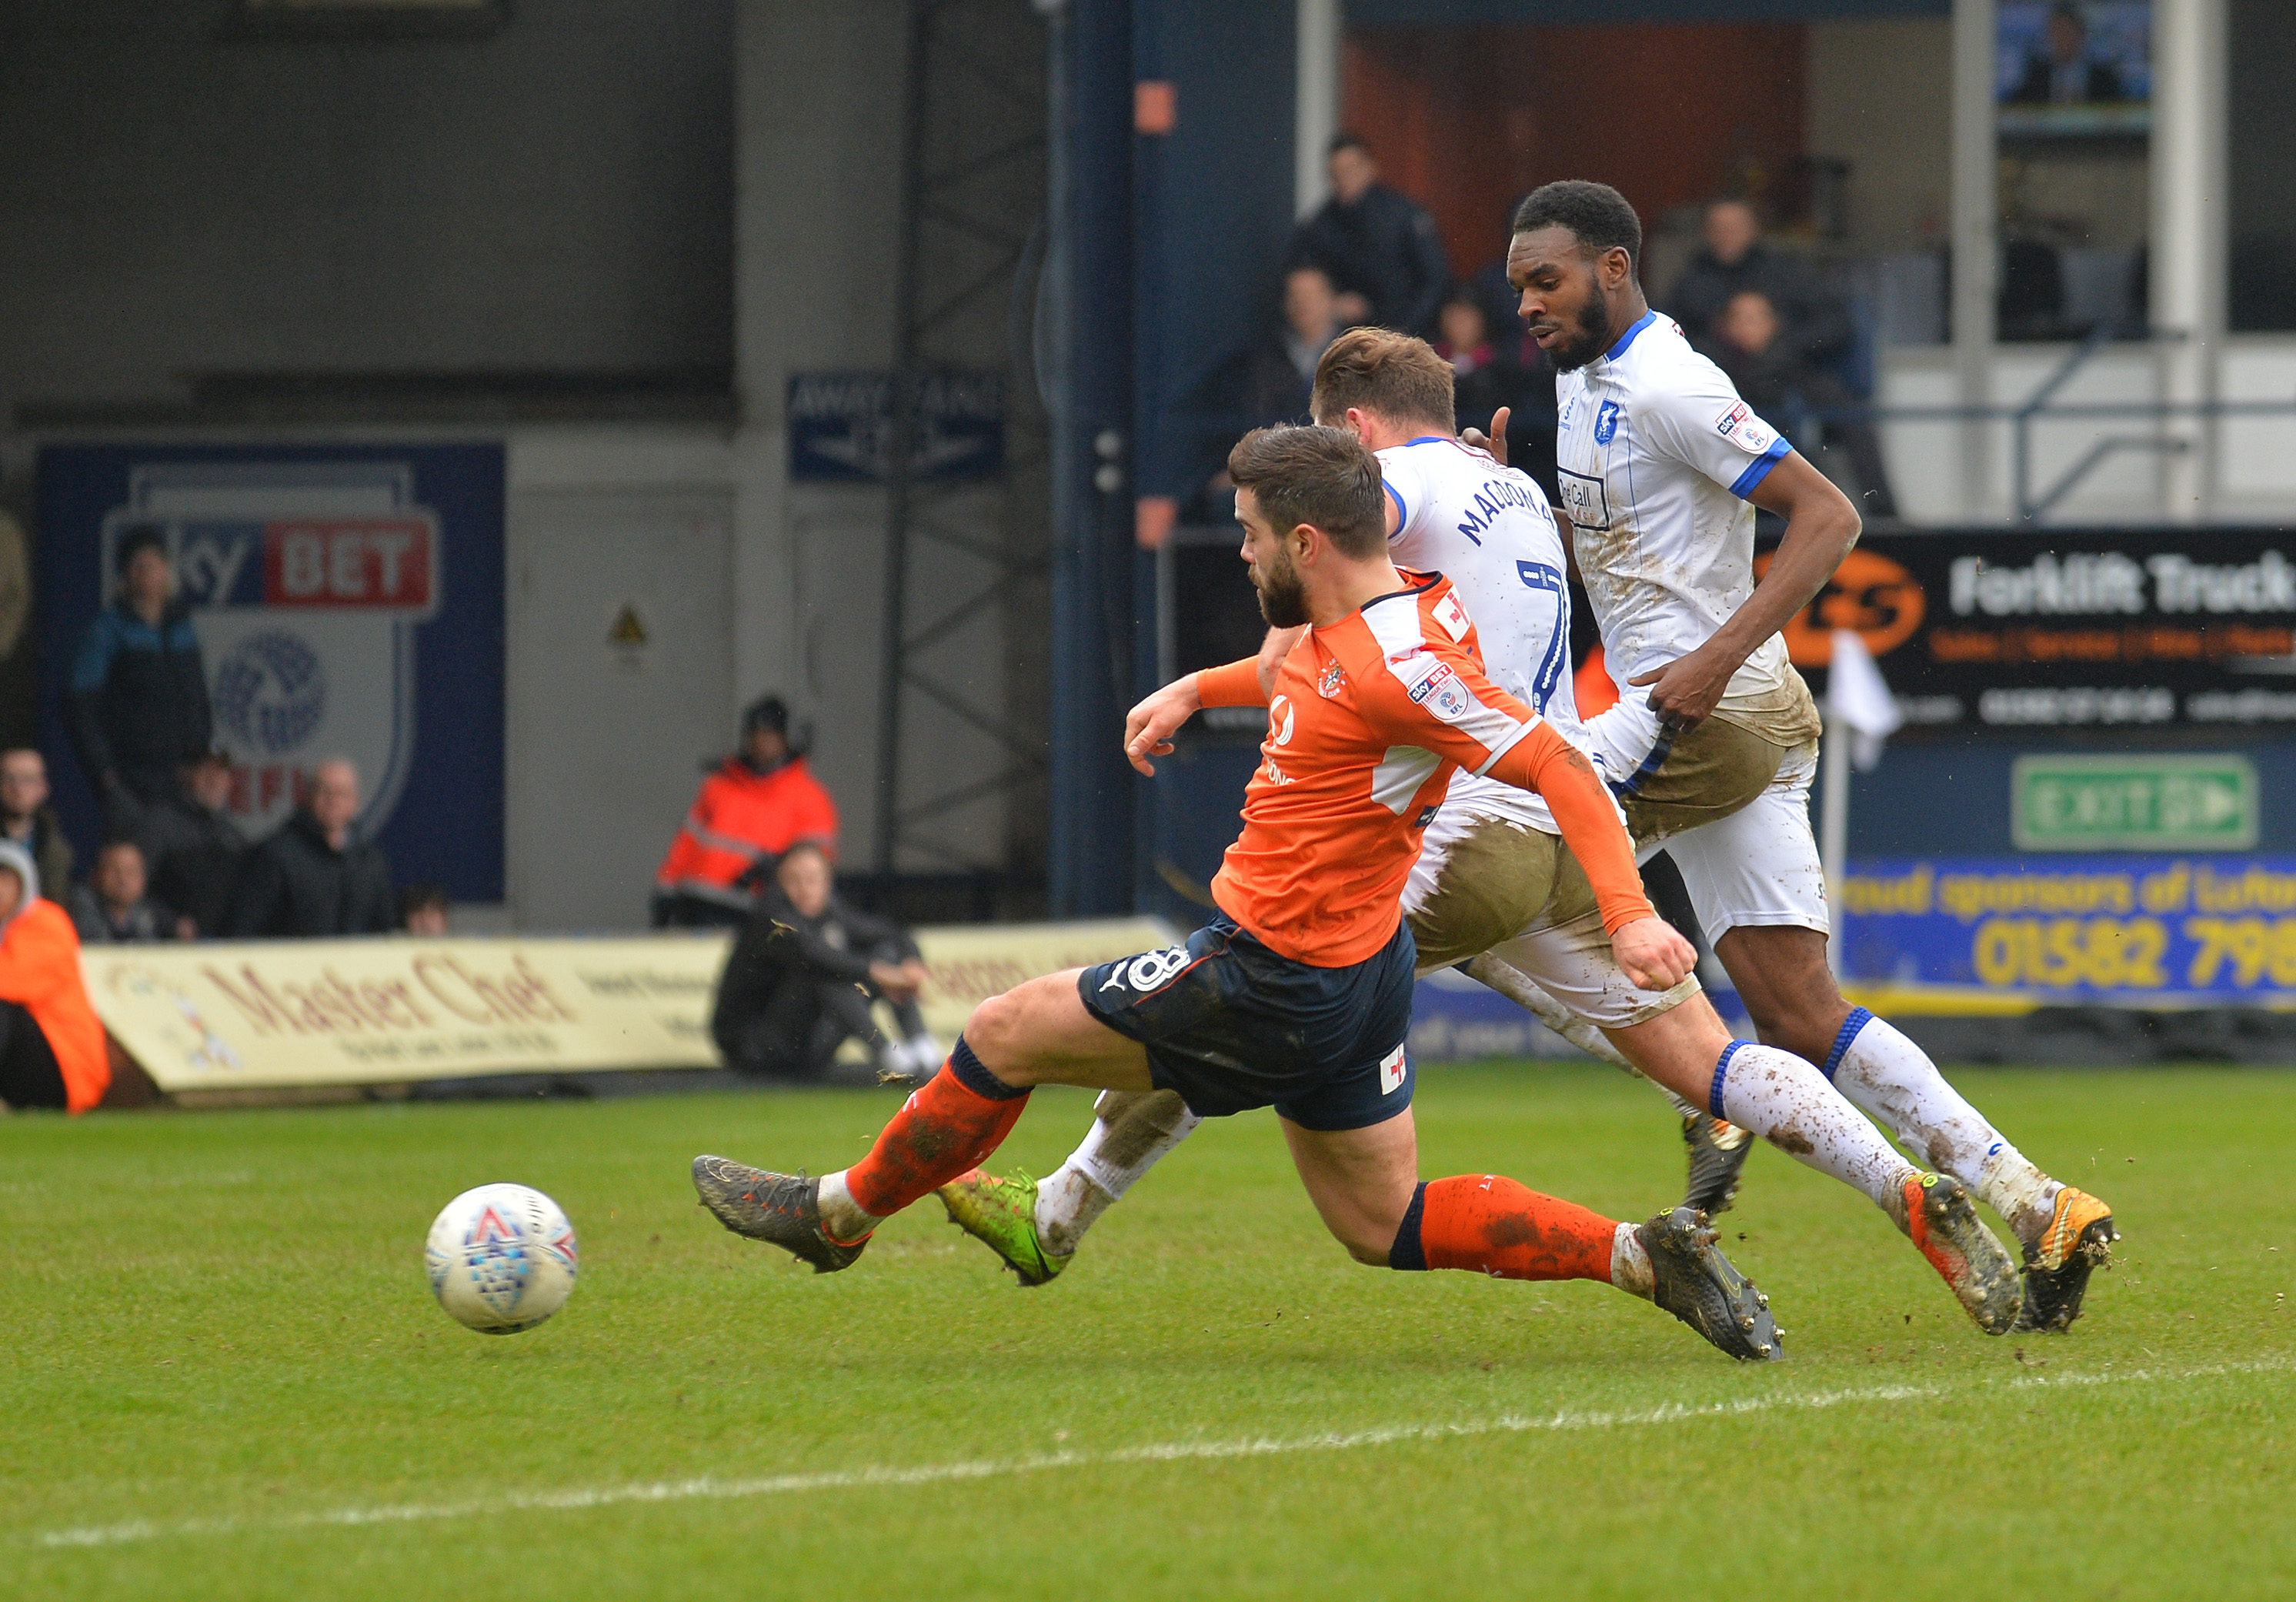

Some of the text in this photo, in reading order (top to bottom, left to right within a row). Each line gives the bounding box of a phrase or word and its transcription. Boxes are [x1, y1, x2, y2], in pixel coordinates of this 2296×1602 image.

[1719, 416, 1735, 433] sky
[1754, 436, 1764, 446] EFL
[1571, 483, 1591, 507] Call
[282, 529, 411, 598] BET
[1949, 552, 2147, 616] Forklift
[1516, 559, 1567, 719] 7
[1413, 665, 1449, 699] sky BET
[1450, 703, 1463, 715] EFL
[2140, 860, 2191, 913] of
[1127, 945, 1191, 992] 8
[1973, 916, 2167, 988] 01582
[199, 948, 579, 1037] Master Chef
